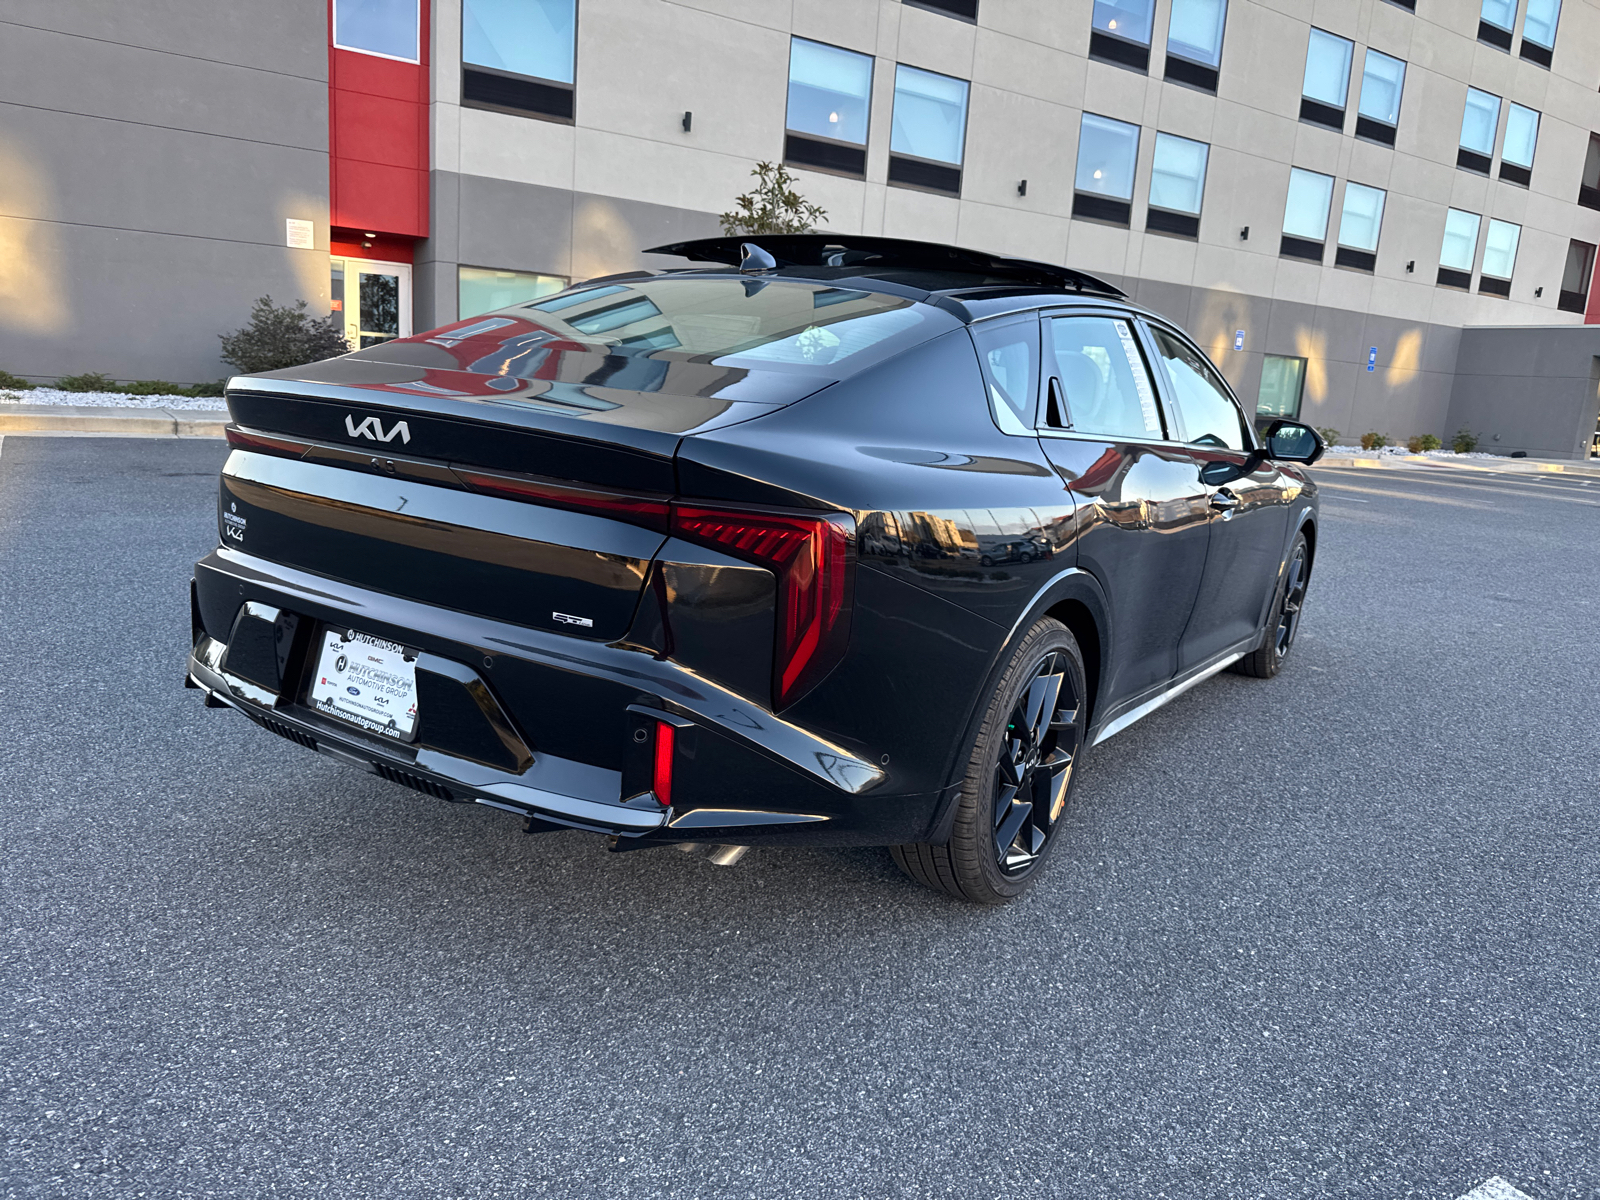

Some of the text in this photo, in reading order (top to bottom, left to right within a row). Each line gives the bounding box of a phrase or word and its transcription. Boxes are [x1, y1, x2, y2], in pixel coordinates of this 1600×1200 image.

[345, 414, 411, 445] KIA
[226, 525, 244, 542] K4
[355, 632, 405, 654] HUTCHINSON
[367, 655, 384, 665] GMC
[346, 674, 408, 699] AUTOMOTIVE GROUP
[347, 661, 414, 691] HUTCHINSON
[338, 696, 394, 718] HUTCHINSONAUTOGROUP.COM
[316, 700, 401, 739] Hutchinsonautogroup.com
